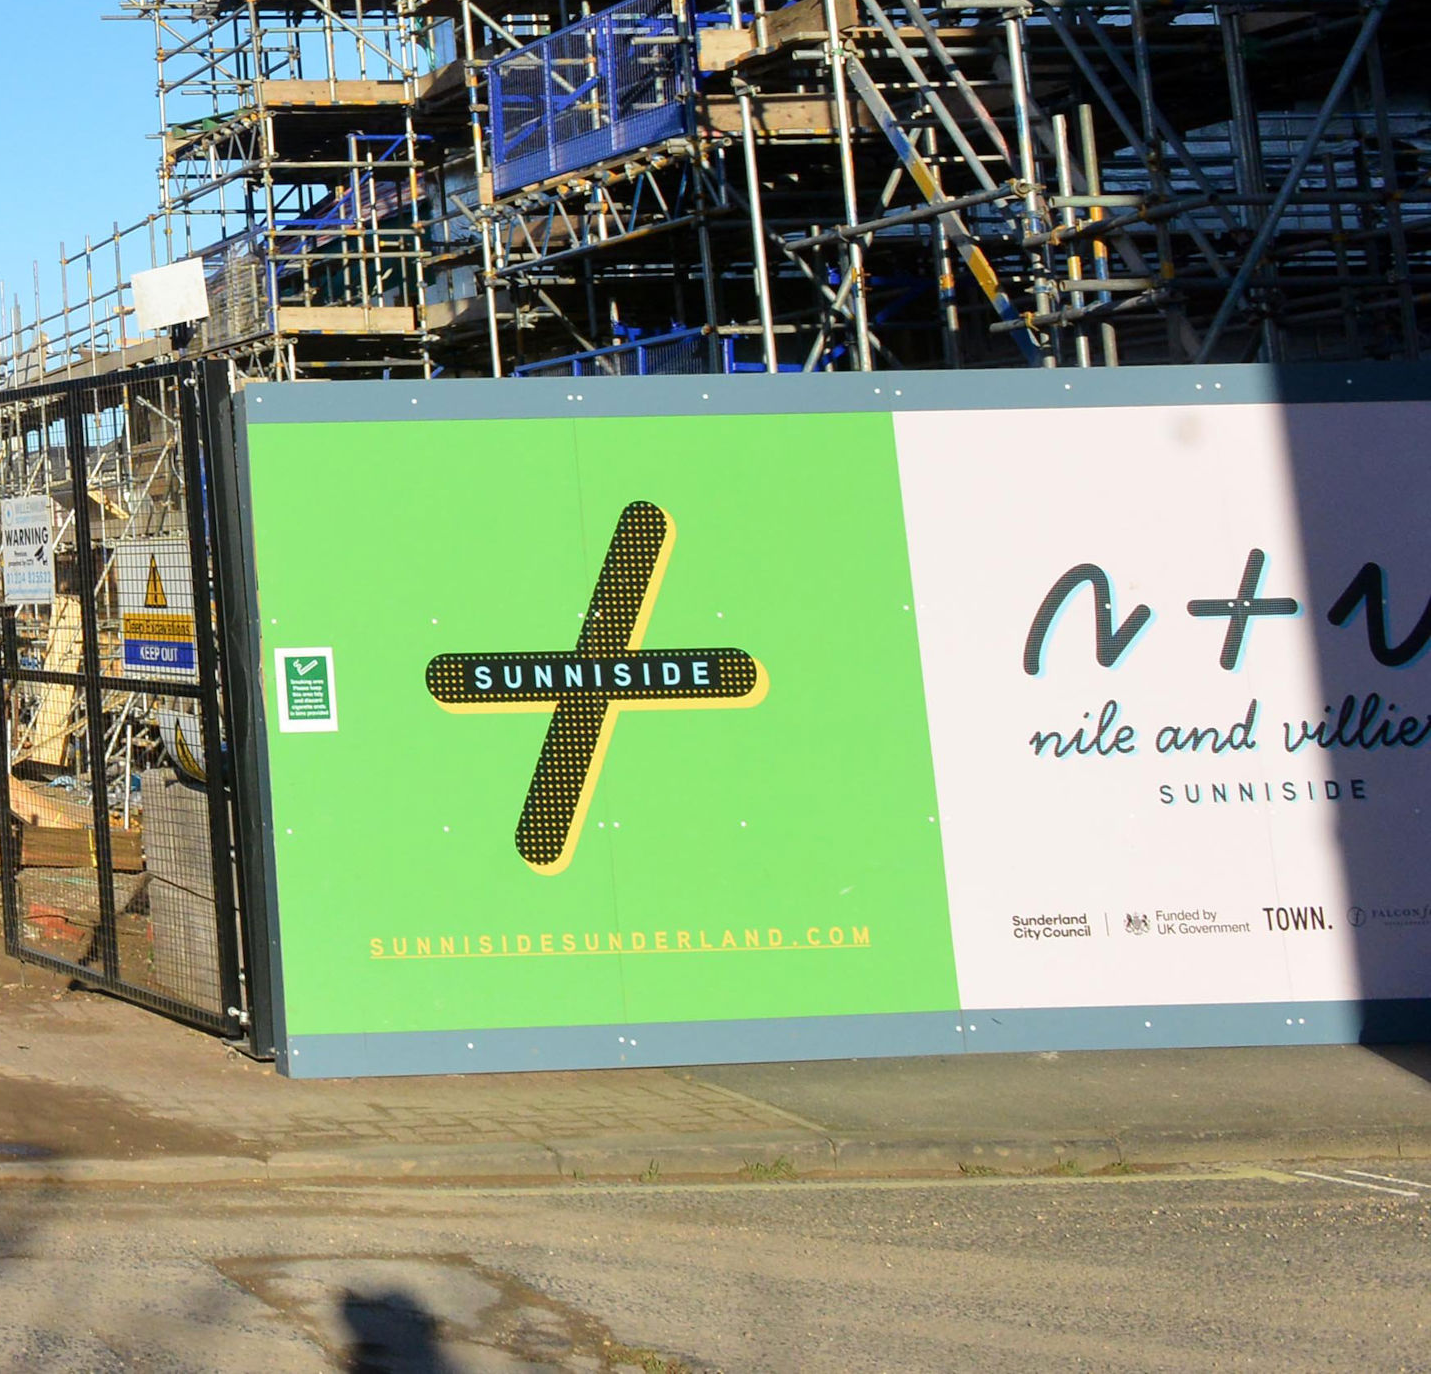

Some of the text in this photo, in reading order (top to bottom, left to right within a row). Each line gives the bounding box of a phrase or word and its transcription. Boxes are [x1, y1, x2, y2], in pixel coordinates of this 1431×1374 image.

[4, 526, 49, 546] WARNING
[140, 646, 178, 662] KEEP OUT
[475, 661, 711, 690] SUNNISIDE
[1029, 692, 1431, 758] nile and villie
[1159, 779, 1367, 805] SUNNISIDE
[1012, 913, 1087, 926] Sunderland
[1155, 909, 1217, 923] Funded by
[1262, 907, 1333, 930] TOWN.
[1014, 925, 1091, 940] City Council
[1157, 922, 1251, 935] UK Government
[370, 926, 871, 957] SUNNISIDESUNDERLAND.COM
